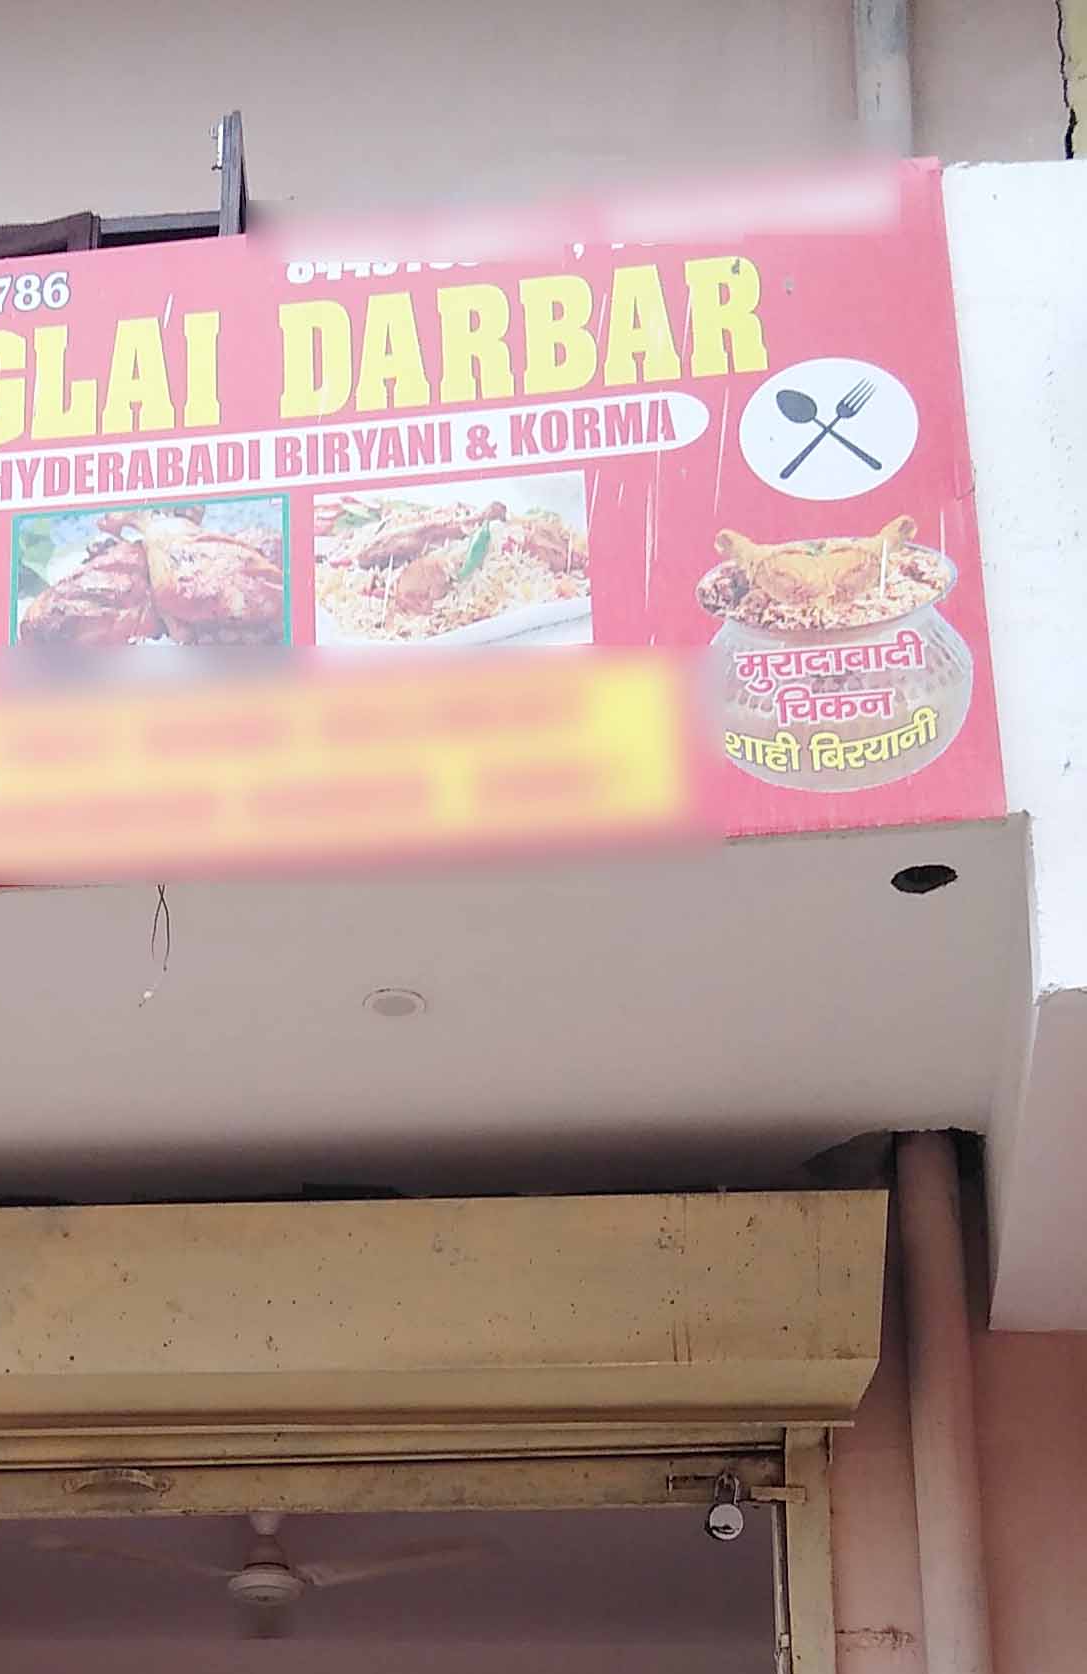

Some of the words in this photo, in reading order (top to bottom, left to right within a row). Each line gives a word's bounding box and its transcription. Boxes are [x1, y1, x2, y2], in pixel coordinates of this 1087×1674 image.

[280, 256, 769, 418] DARBAR
[274, 421, 452, 482] BIRYANI
[465, 423, 498, 461] &
[510, 400, 677, 457] KORMA
[735, 628, 926, 694] मुरादाबादी
[724, 729, 802, 773] शाही
[808, 705, 940, 773] बिरयानी
[774, 684, 895, 727] चिकन
